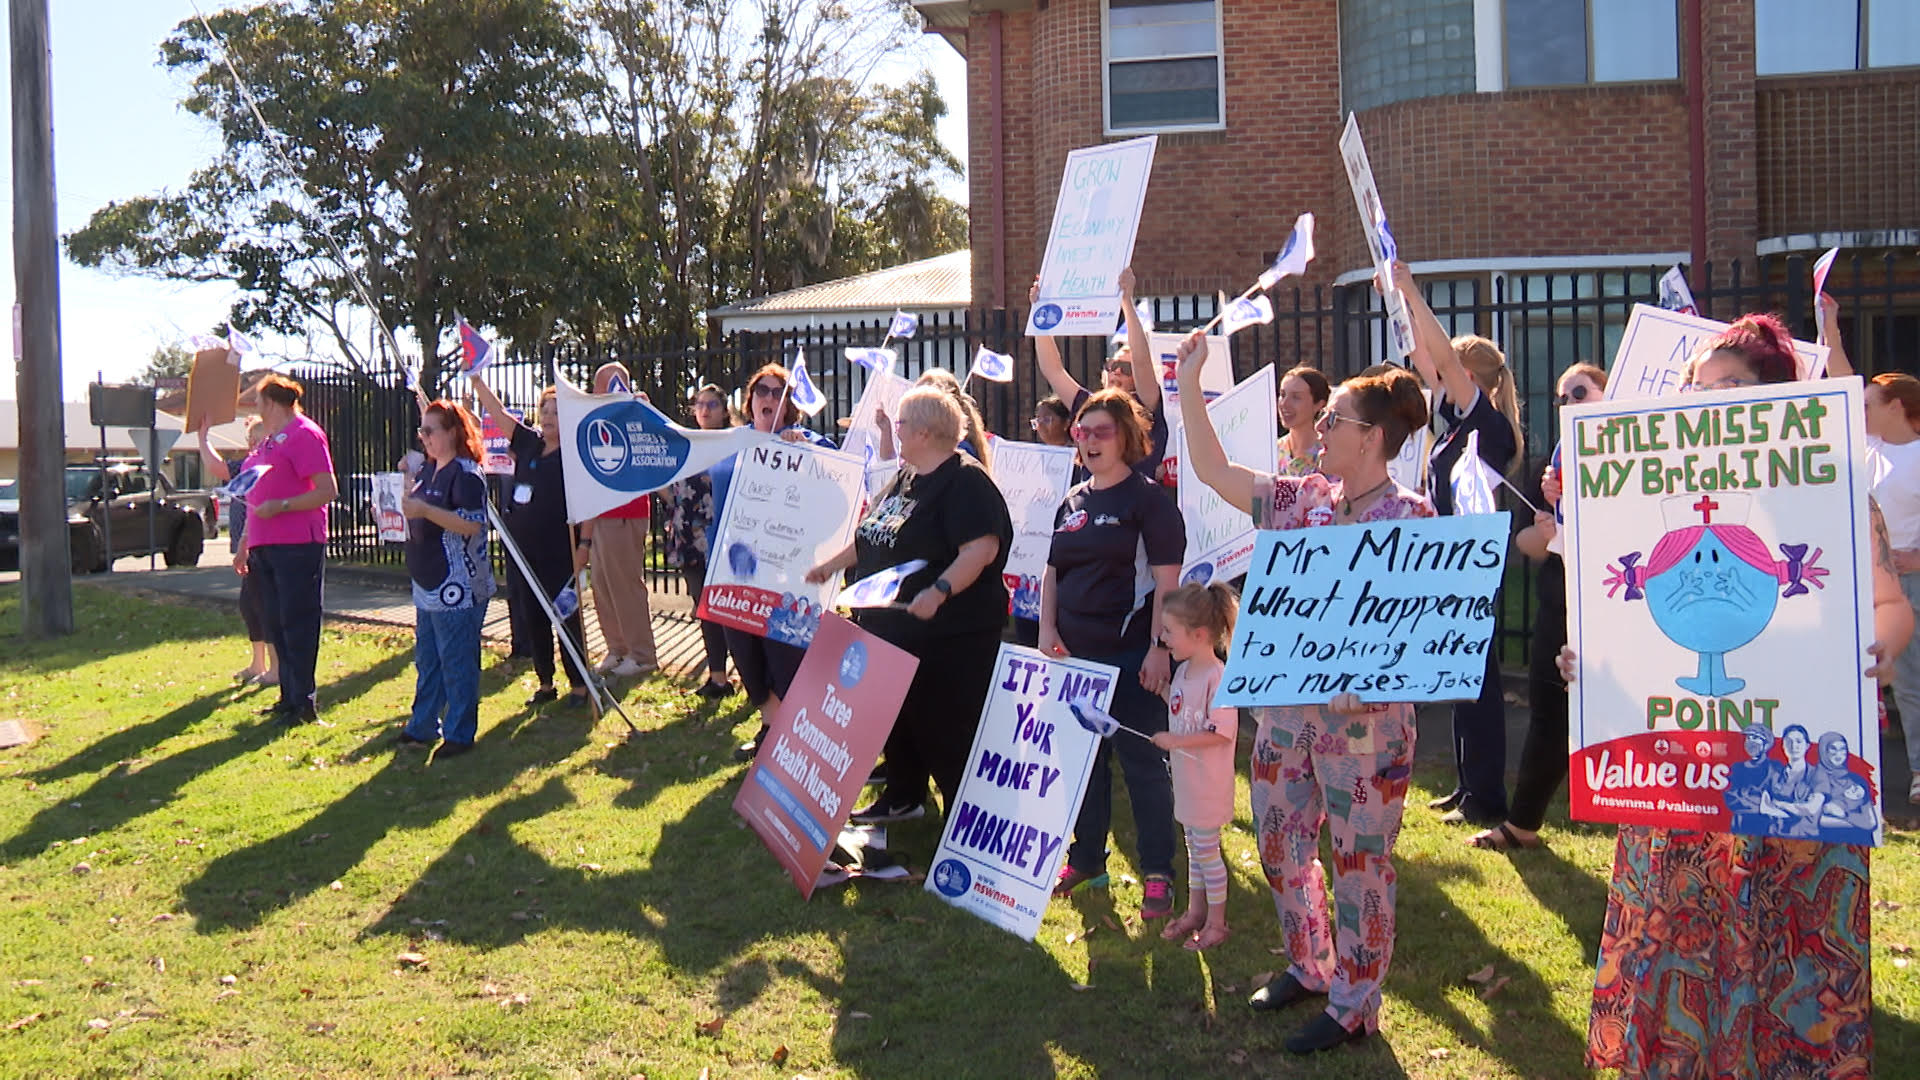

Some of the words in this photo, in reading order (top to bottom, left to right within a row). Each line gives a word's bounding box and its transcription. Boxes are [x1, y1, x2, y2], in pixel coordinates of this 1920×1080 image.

[1074, 157, 1122, 190] GROW
[1059, 267, 1107, 293] HEALTH
[626, 421, 643, 432] NSW
[631, 455, 678, 468] ASSOCIATION
[753, 447, 803, 472] NSW
[1579, 459, 1635, 498] MY
[1265, 537, 1331, 576] Mr
[1348, 526, 1501, 573] Minns
[708, 587, 751, 612] Value
[753, 602, 773, 618] us
[1247, 579, 1345, 622] What
[1241, 631, 1276, 660] to
[1290, 632, 1408, 670] looking
[1423, 629, 1490, 656] after
[1058, 671, 1110, 709] NOT
[1227, 673, 1287, 694] our
[820, 683, 853, 728] Taree
[792, 707, 854, 782] Community
[771, 734, 809, 787] Health
[803, 763, 842, 820] Nurses
[976, 749, 1061, 798] MONEY
[1585, 749, 1678, 791] Value
[1684, 763, 1730, 790] us
[1592, 794, 1655, 811] #nswnma
[1657, 799, 1719, 815] #valueus
[951, 801, 1062, 878] MOOKHEY
